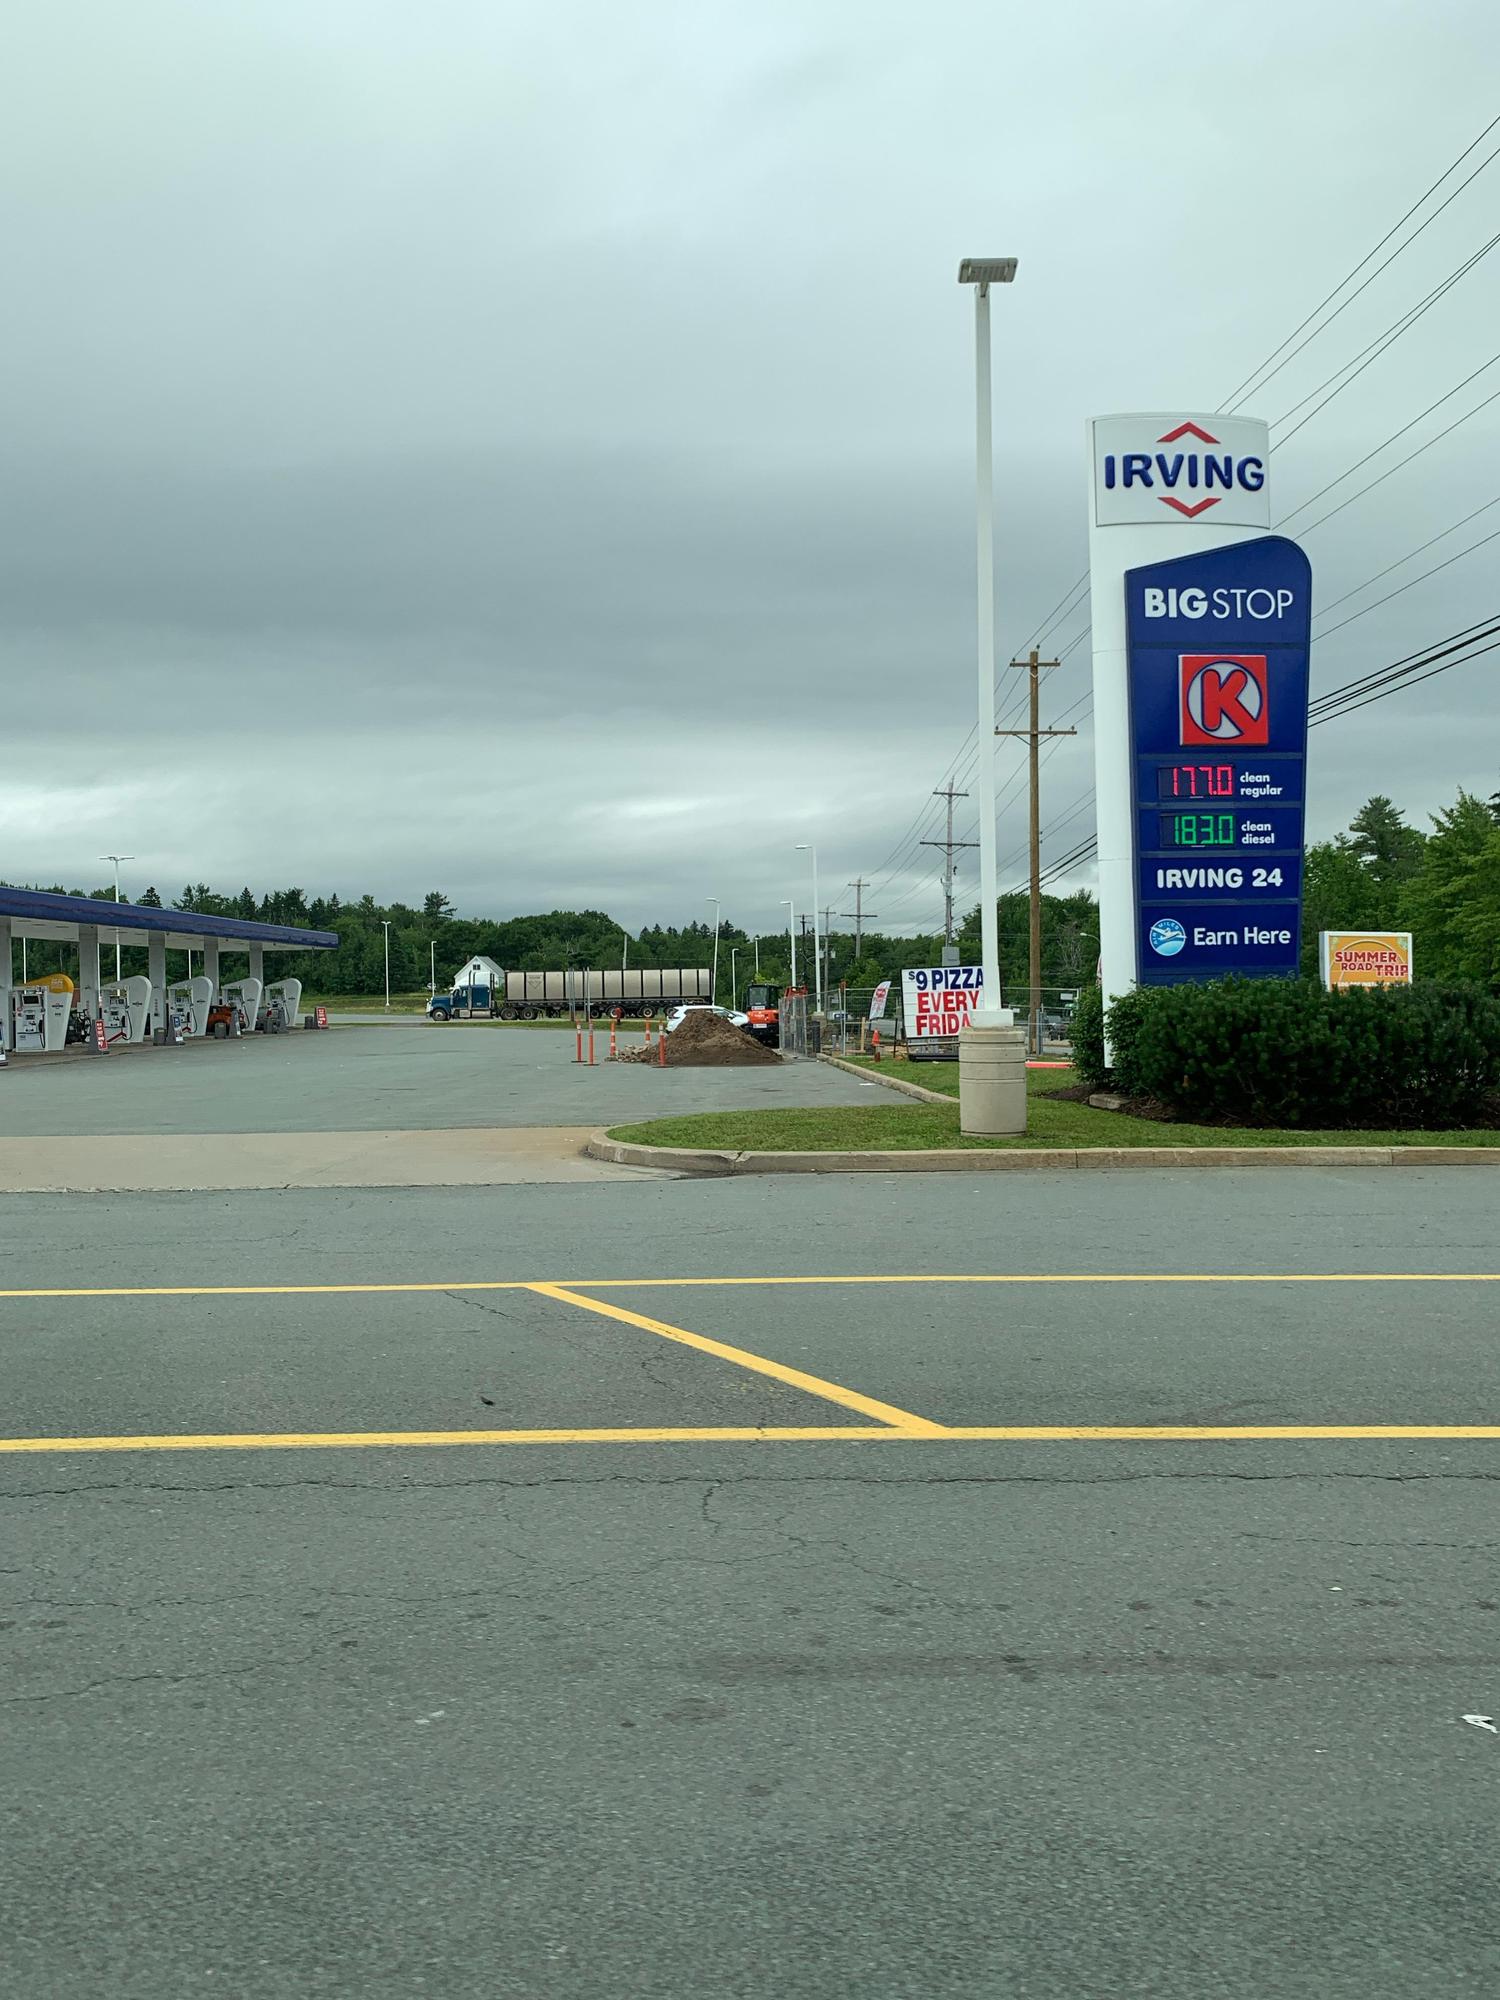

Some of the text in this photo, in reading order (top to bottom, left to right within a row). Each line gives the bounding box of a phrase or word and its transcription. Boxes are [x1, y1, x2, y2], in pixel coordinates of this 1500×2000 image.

[1104, 453, 1265, 492] IRVING
[1144, 587, 1293, 619] BIG STOP
[1201, 667, 1261, 736] K
[1240, 772, 1270, 783] clean
[1240, 785, 1282, 798] regular
[1241, 821, 1271, 832] clean
[1241, 833, 1275, 844] diesel
[1157, 868, 1283, 888] IRVING 24
[1194, 927, 1291, 946] Earn Here
[1335, 951, 1397, 963] SUMMER
[1341, 962, 1409, 977] ROAD TRIP
[917, 990, 980, 1014] EVERY
[916, 1013, 972, 1036] FRIDA
